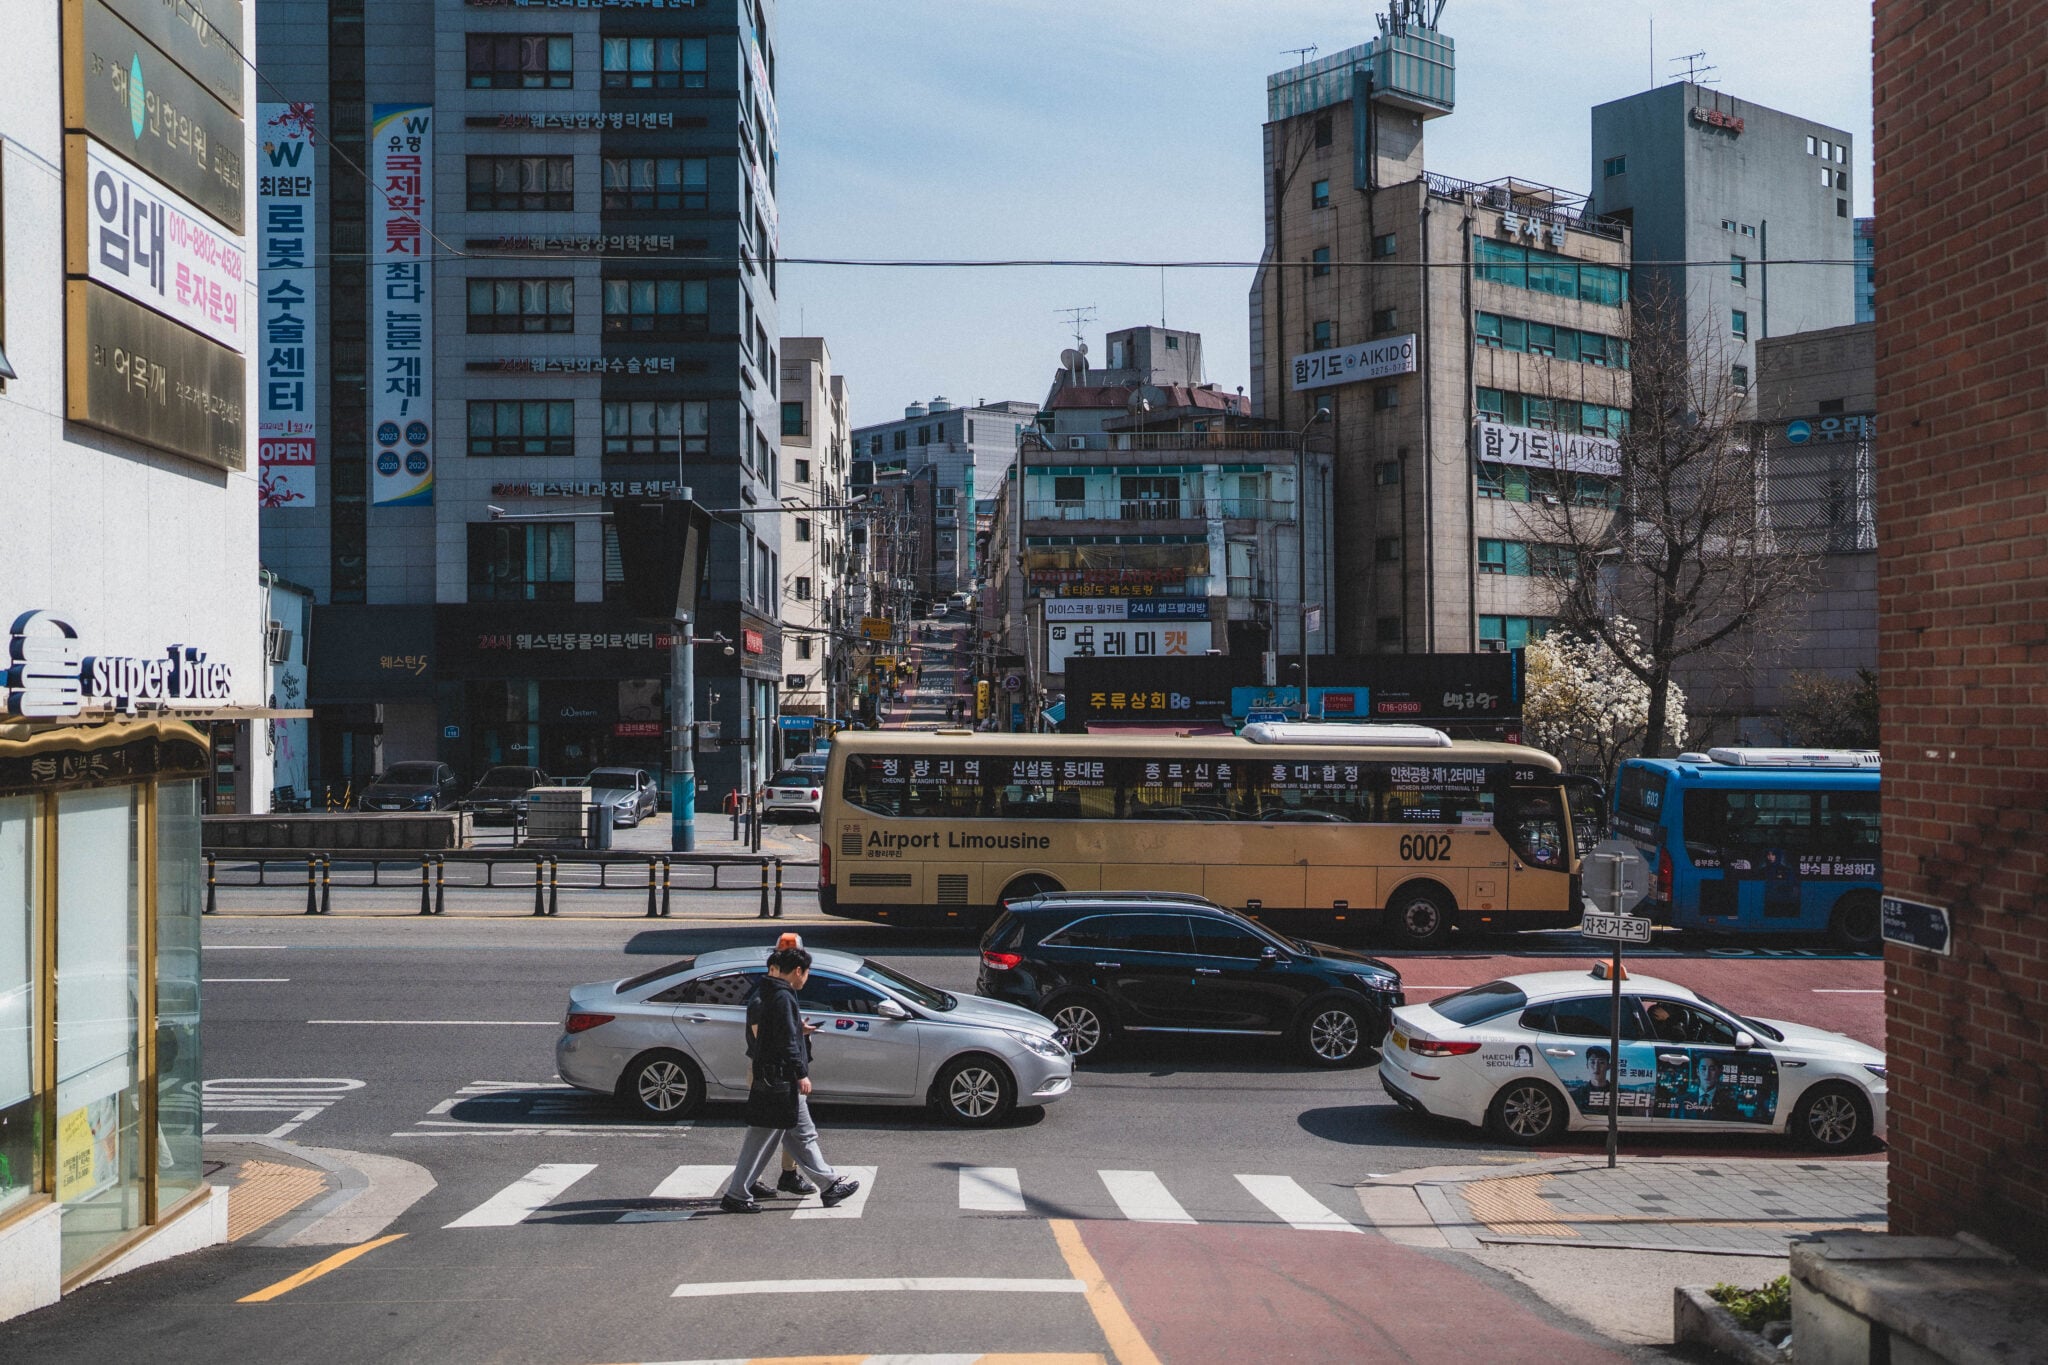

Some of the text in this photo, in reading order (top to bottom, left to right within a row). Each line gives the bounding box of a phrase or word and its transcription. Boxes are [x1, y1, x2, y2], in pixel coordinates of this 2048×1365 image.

[387, 136, 422, 152] 유명
[259, 175, 313, 198] 최첨단
[385, 155, 425, 258] 국제학술지
[94, 170, 166, 297] 임대
[1503, 211, 1567, 247] 독서실
[169, 211, 242, 283] 010-8802-4528
[175, 262, 238, 334] 문자문의
[1294, 342, 1413, 385] 합기도 AIKIDO
[114, 347, 167, 407] 어목깨
[380, 432, 399, 442] 2023
[408, 432, 427, 442] 2022
[1483, 427, 1548, 462] 합기도
[260, 442, 313, 461] OPEN
[380, 462, 399, 471] 2020
[408, 462, 427, 471] 2022
[1130, 601, 1207, 614] 24시 셀프빨래방
[515, 631, 654, 650] 웨스턴동물의료센터
[1053, 629, 1066, 639] 2F
[82, 654, 176, 714] super
[172, 644, 233, 700] bites
[1089, 691, 1191, 710] 주류상회 Be
[1381, 703, 1419, 712] 716-0900
[1390, 766, 1431, 783] 인천공항
[1515, 771, 1535, 780] 215
[1646, 789, 1659, 808] 603
[843, 824, 862, 833] 우등
[867, 830, 1051, 850] Airport Limousine
[1399, 834, 1452, 861] 6002
[866, 849, 903, 858] 공항리무진
[1799, 862, 1877, 876] 방수를 완성하다
[1585, 917, 1647, 939] 자전거주의
[1683, 1100, 1714, 1113] Disney+
